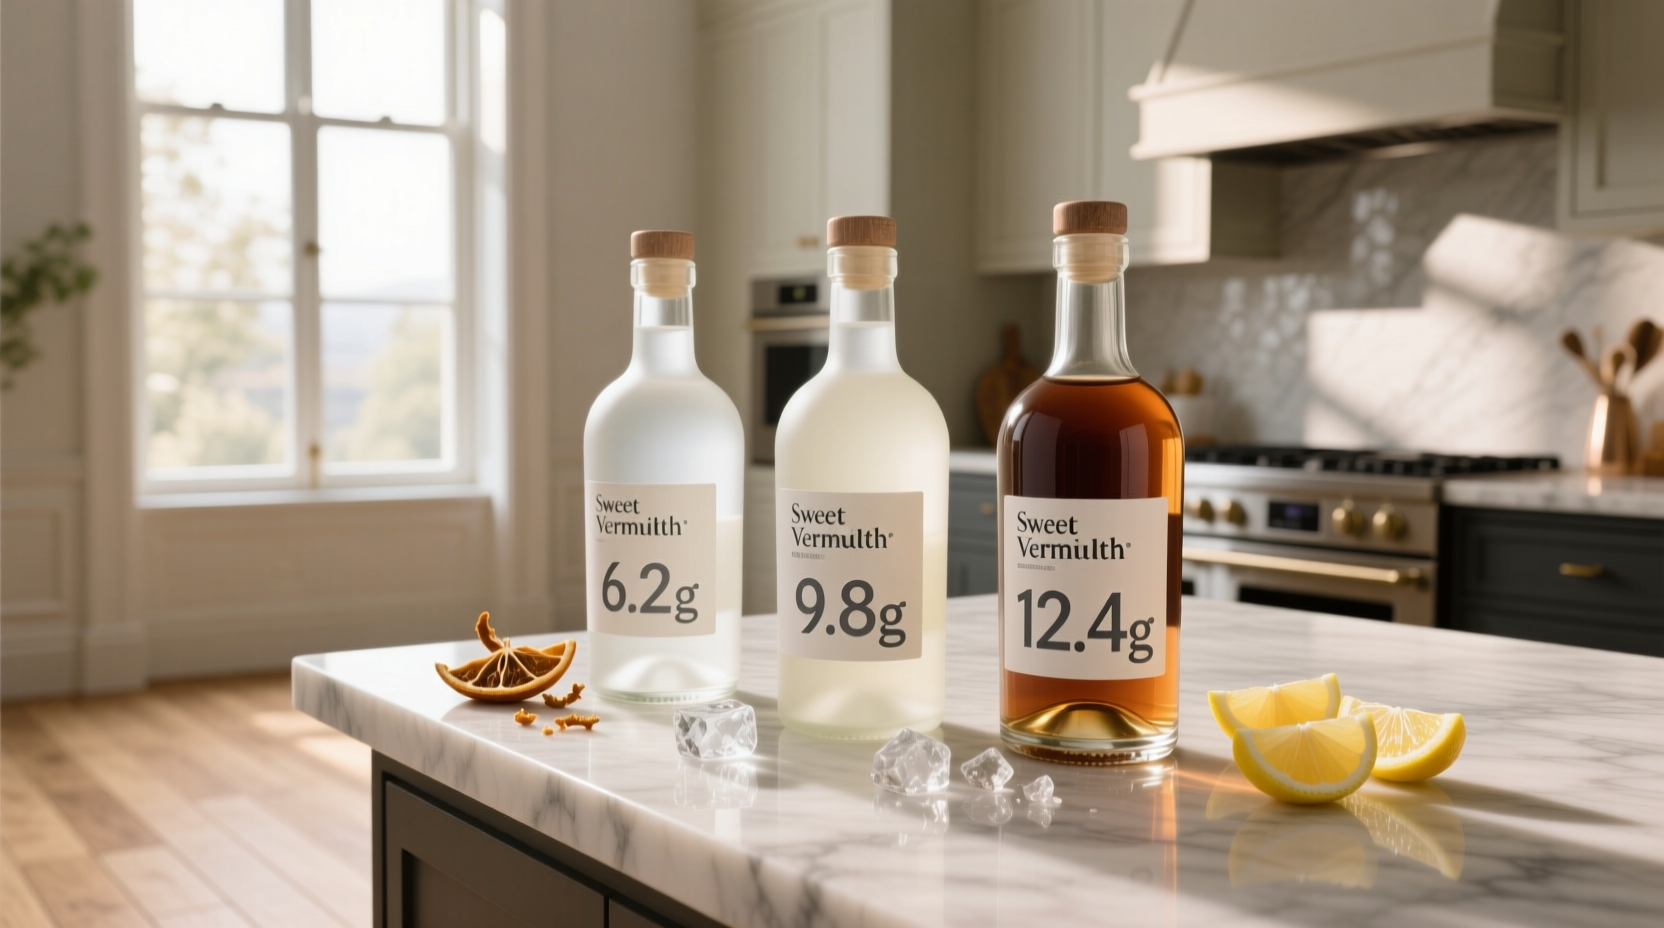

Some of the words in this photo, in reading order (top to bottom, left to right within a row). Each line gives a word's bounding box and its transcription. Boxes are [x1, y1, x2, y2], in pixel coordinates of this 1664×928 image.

[595, 493, 641, 515] Sweet
[791, 502, 847, 525] Sweet
[1017, 510, 1079, 536] Sweet
[602, 561, 700, 624] 6.2g
[795, 577, 907, 648] 9.8g
[1017, 588, 1155, 664] 12.4g
